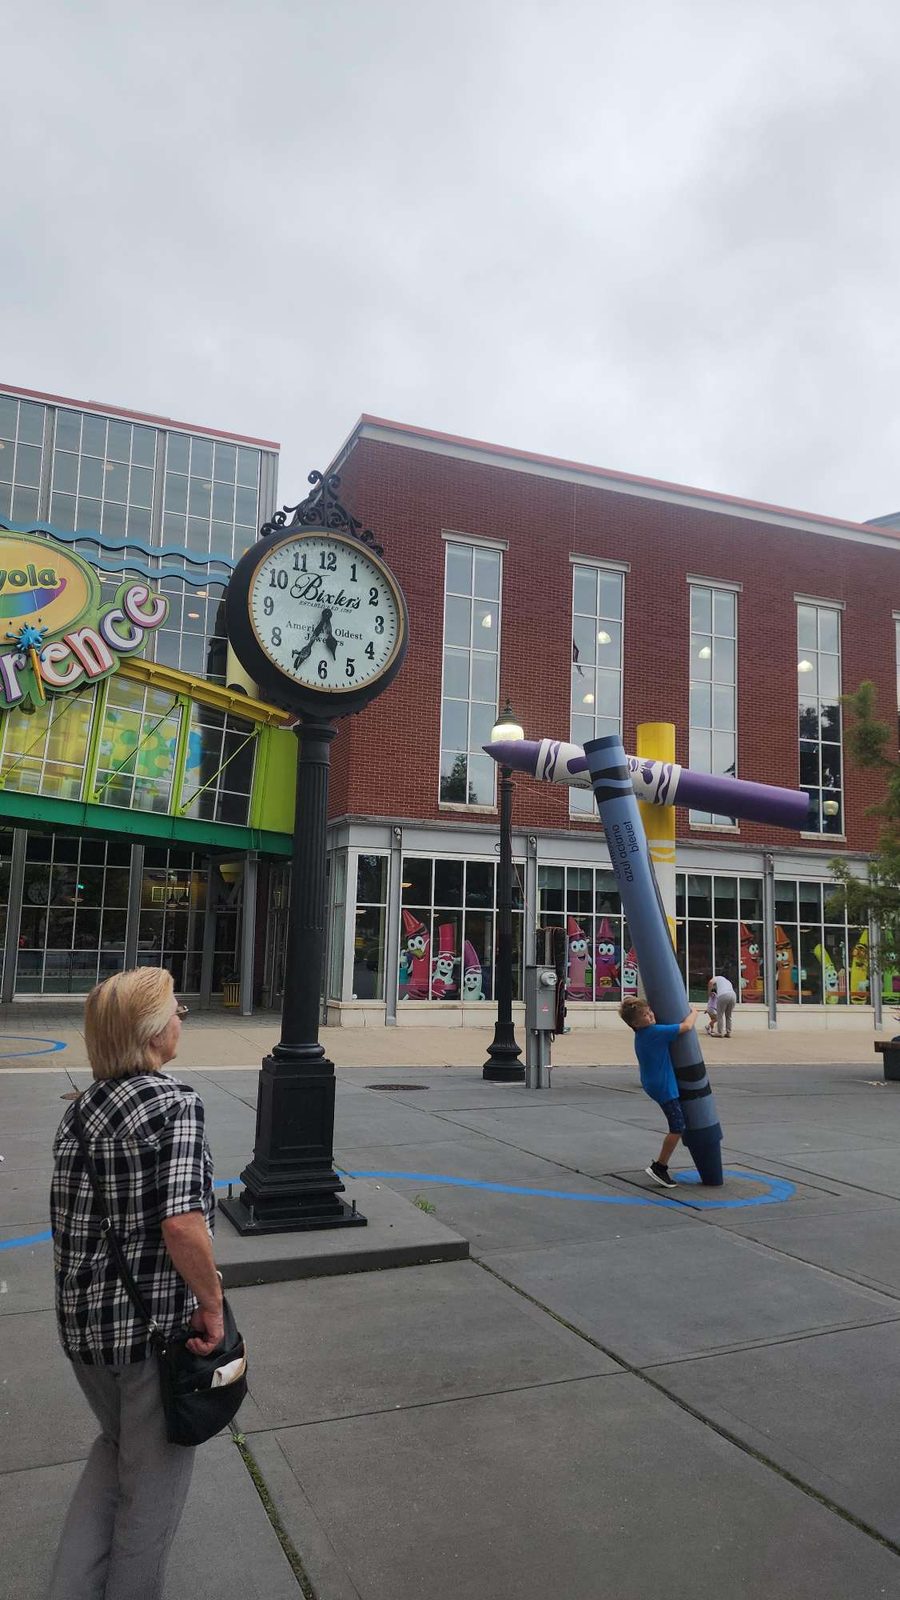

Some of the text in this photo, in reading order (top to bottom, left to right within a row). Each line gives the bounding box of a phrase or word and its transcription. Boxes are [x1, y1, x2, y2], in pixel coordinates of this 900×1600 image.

[292, 551, 308, 572] 11
[319, 551, 337, 571] 12
[269, 568, 289, 589] 10
[350, 563, 358, 582] 1
[263, 596, 274, 616] 9
[368, 587, 379, 606] 2
[335, 628, 363, 640] Oldest
[374, 615, 385, 635] 3
[0, 584, 168, 703] rience
[271, 626, 282, 647] 8
[291, 649, 303, 669] 7
[364, 641, 375, 660] 4
[317, 660, 328, 680] 6
[345, 658, 355, 677] 5
[623, 821, 639, 852] bleuet
[620, 861, 633, 882] azul
